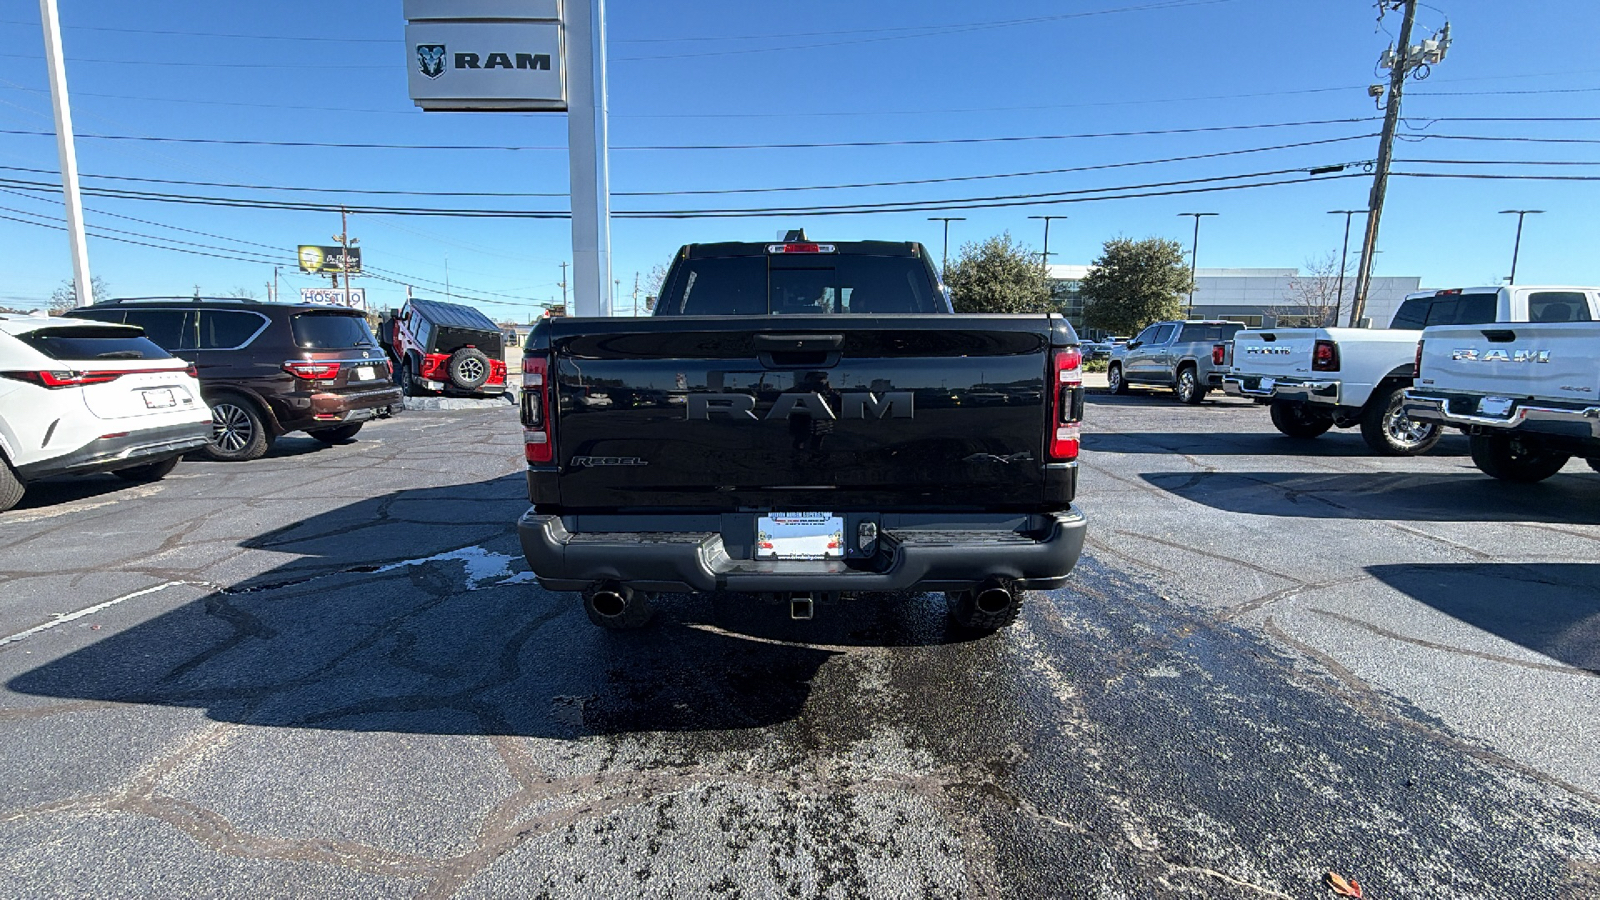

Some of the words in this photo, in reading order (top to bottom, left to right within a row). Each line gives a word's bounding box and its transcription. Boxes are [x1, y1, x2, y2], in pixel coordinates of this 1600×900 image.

[454, 53, 551, 70] RAM
[304, 292, 361, 303] HOSTIO
[1452, 348, 1550, 363] RAM
[686, 391, 914, 421] RAM
